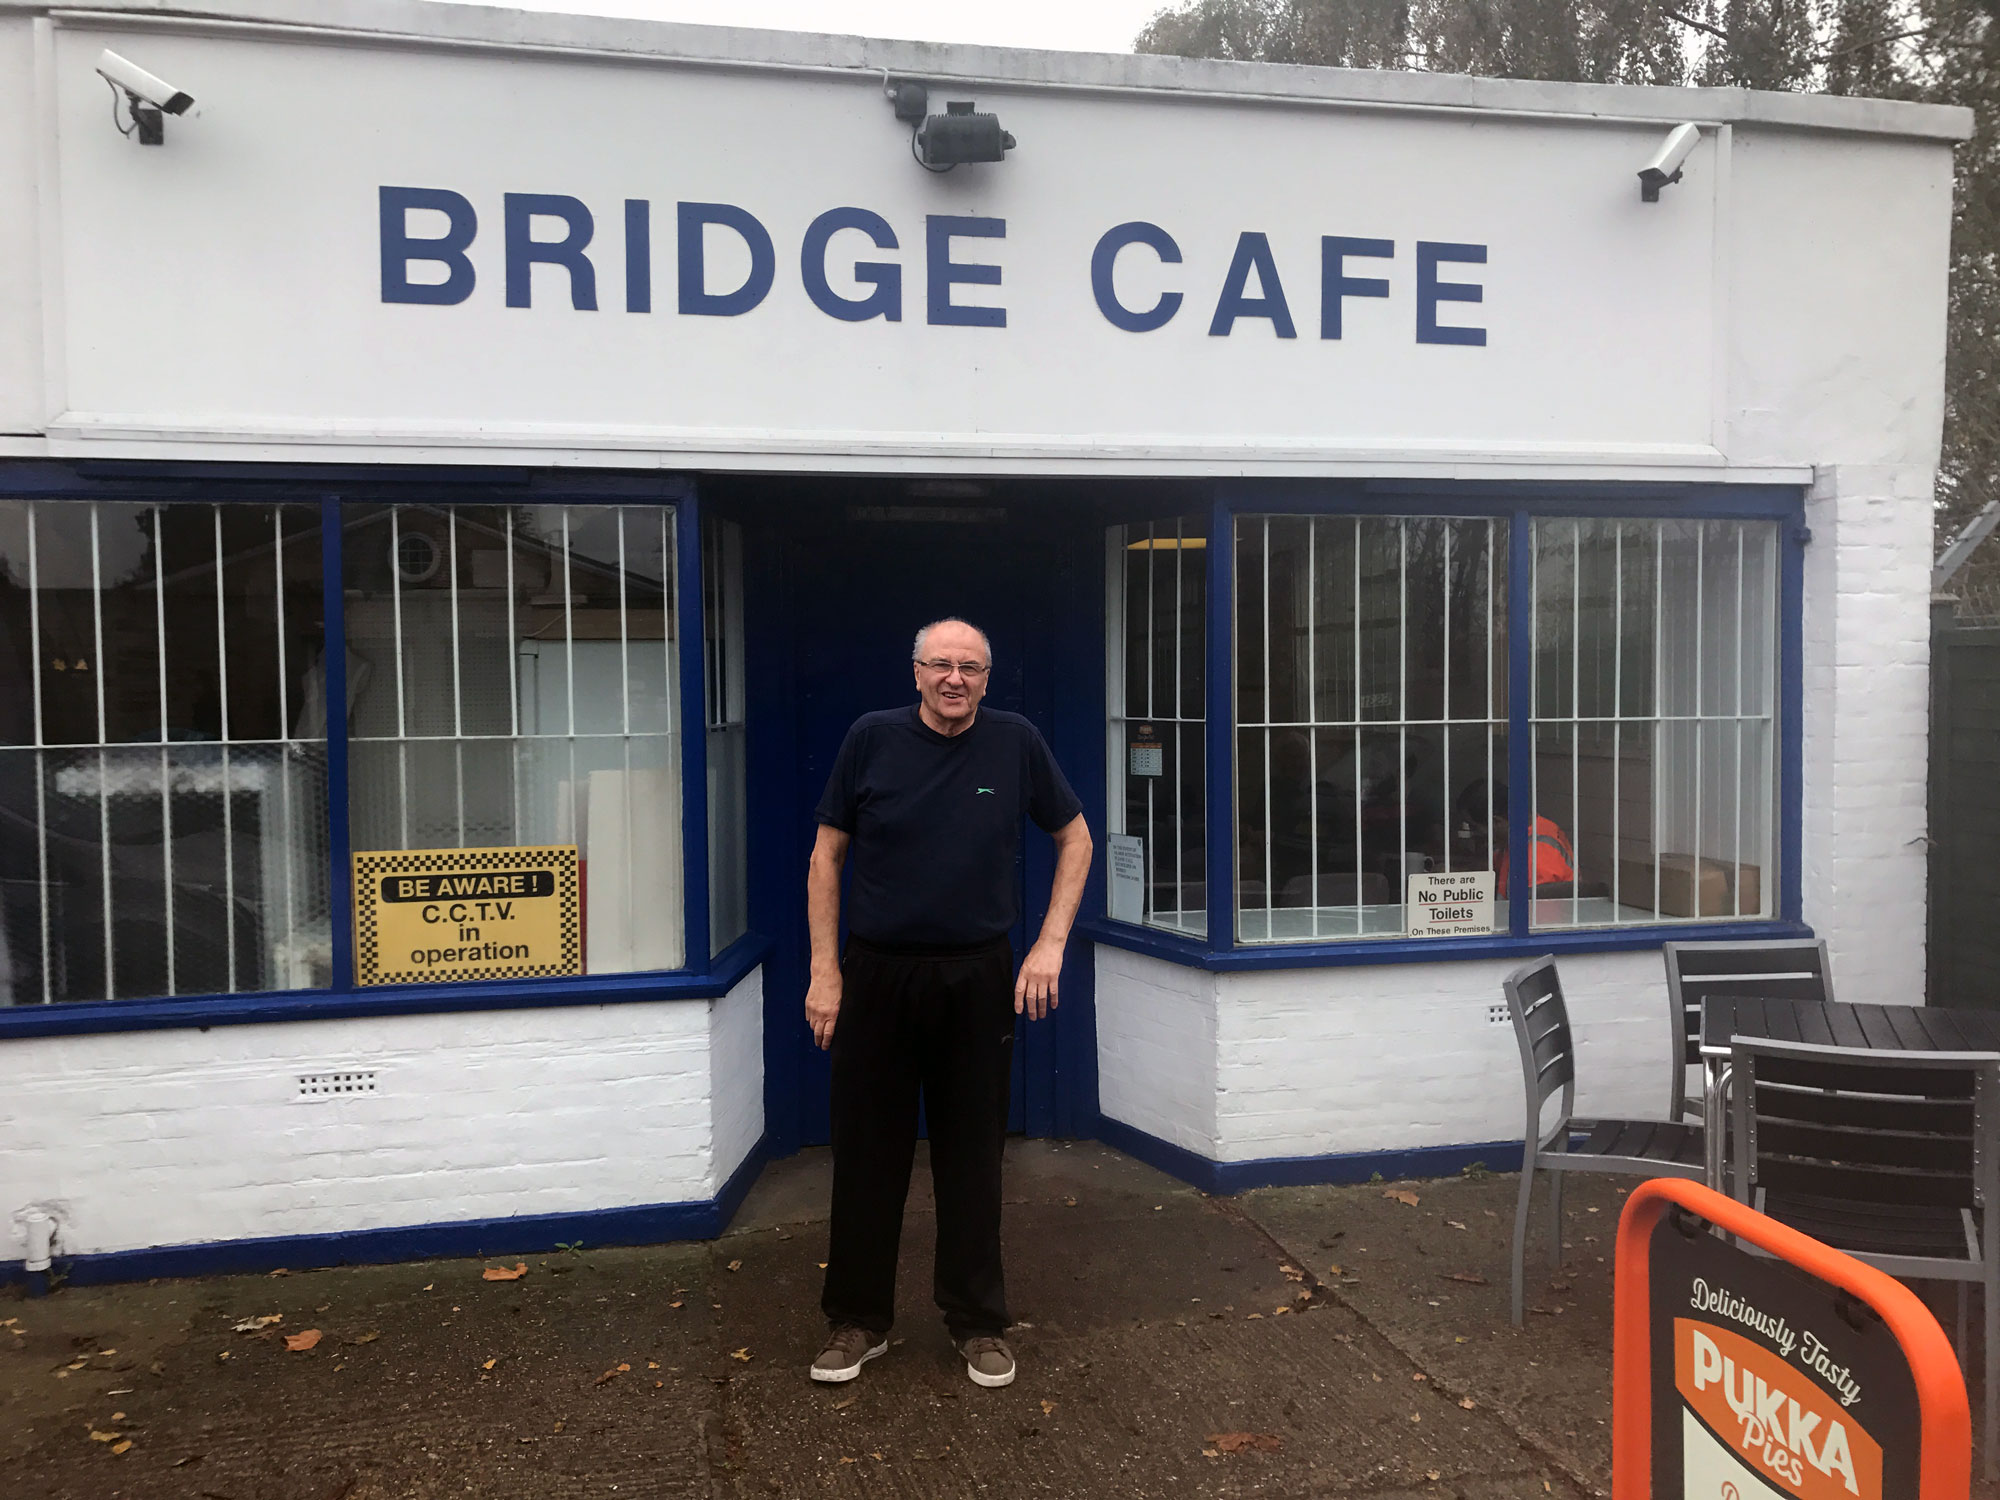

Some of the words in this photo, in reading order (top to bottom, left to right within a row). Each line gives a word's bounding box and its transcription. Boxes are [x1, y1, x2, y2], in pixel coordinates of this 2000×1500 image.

[379, 186, 1007, 328] BRIDGE
[1091, 221, 1488, 347] CAFE
[398, 879, 430, 898] BE
[436, 875, 526, 897] AWARE
[1428, 876, 1456, 885] There
[1460, 876, 1476, 884] are
[1418, 890, 1437, 902] No
[1443, 888, 1484, 901] Public
[422, 902, 516, 924] C.C.T.V.
[1429, 907, 1474, 920] Toilets
[459, 924, 480, 942] in
[1411, 928, 1424, 936] On
[1426, 927, 1451, 935] These
[1454, 925, 1491, 933] Premises
[410, 941, 530, 967] operation
[1690, 1277, 1797, 1357] Deliciously
[1800, 1330, 1862, 1407] Tasty
[1693, 1329, 1860, 1497] PUKKA
[1738, 1411, 1803, 1487] Pies
